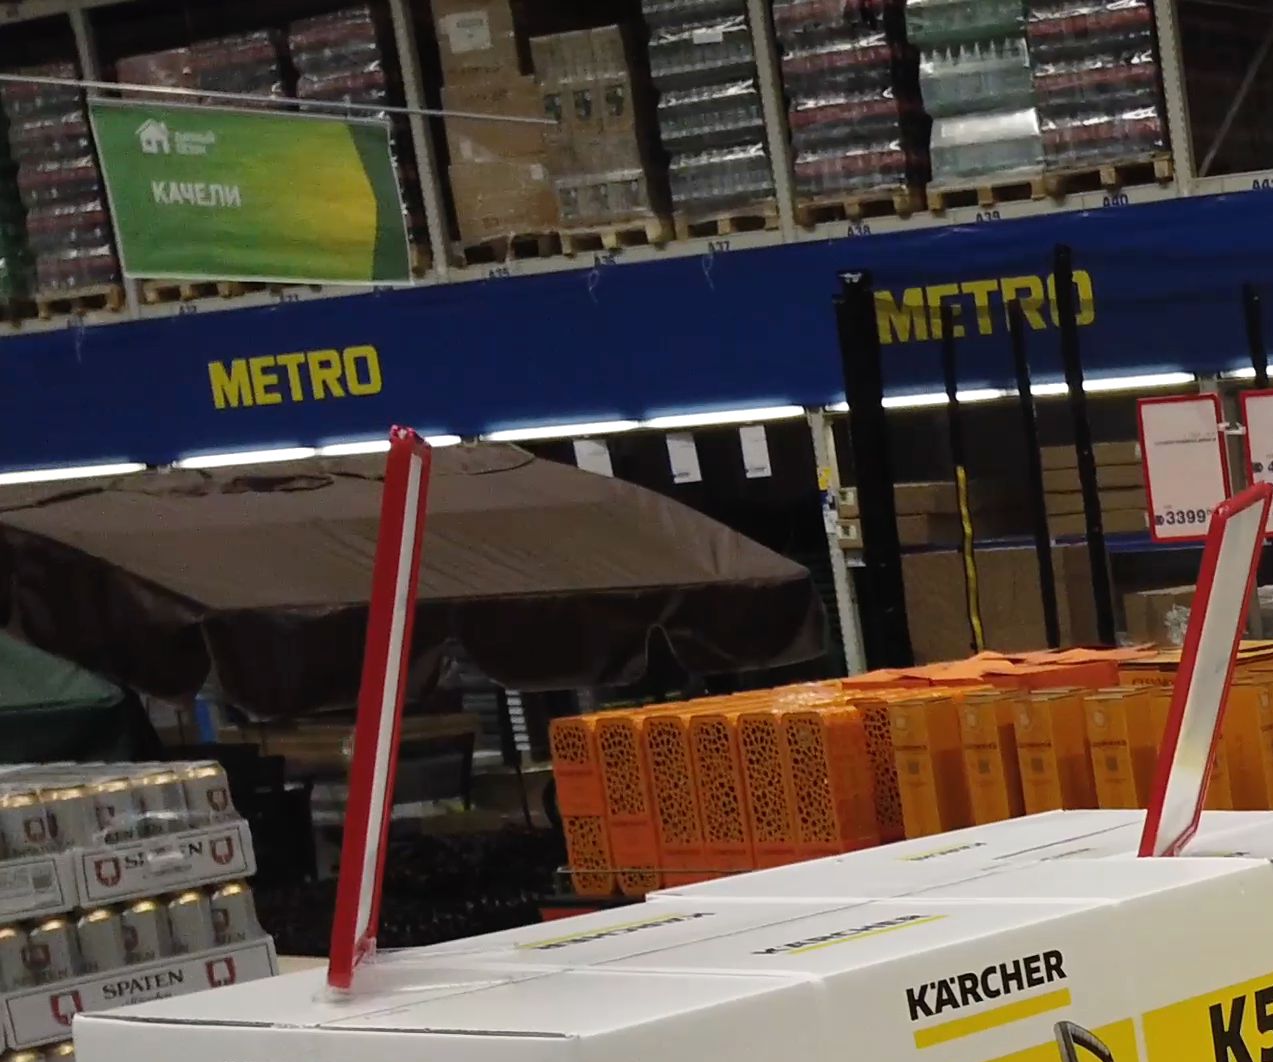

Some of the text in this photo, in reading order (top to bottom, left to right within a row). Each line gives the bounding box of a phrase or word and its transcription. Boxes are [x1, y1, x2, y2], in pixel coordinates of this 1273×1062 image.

[152, 180, 242, 207] КАЧЕЛИ
[877, 269, 1095, 345] METRO
[208, 344, 382, 410] METRO
[102, 969, 184, 1000] SPATEN
[907, 949, 1067, 1020] KÄRCHER
